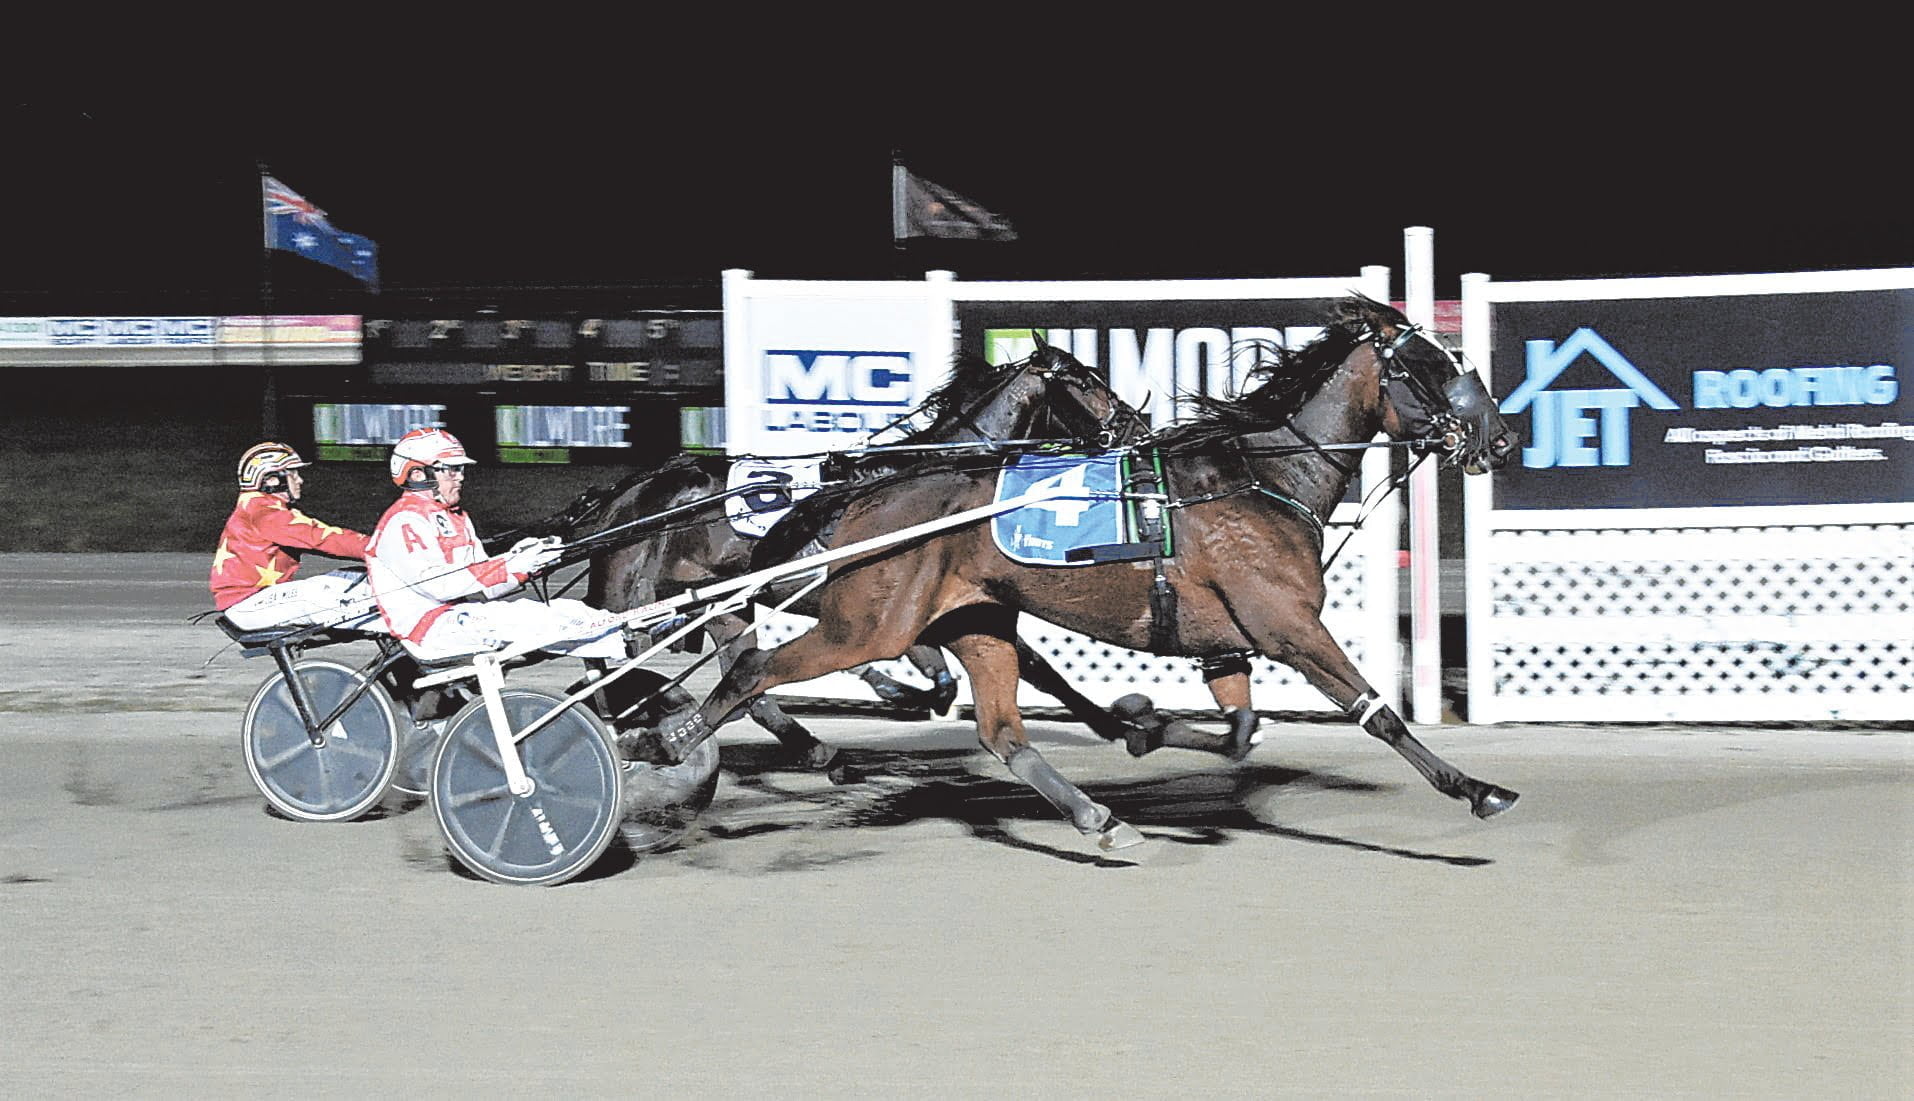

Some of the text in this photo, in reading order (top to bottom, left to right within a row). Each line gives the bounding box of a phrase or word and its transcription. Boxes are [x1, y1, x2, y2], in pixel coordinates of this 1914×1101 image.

[764, 350, 910, 406] MC
[1693, 365, 1897, 410] ROOFING
[1522, 388, 1640, 468] JET
[1022, 463, 1090, 526] 4
[401, 523, 428, 554] A
